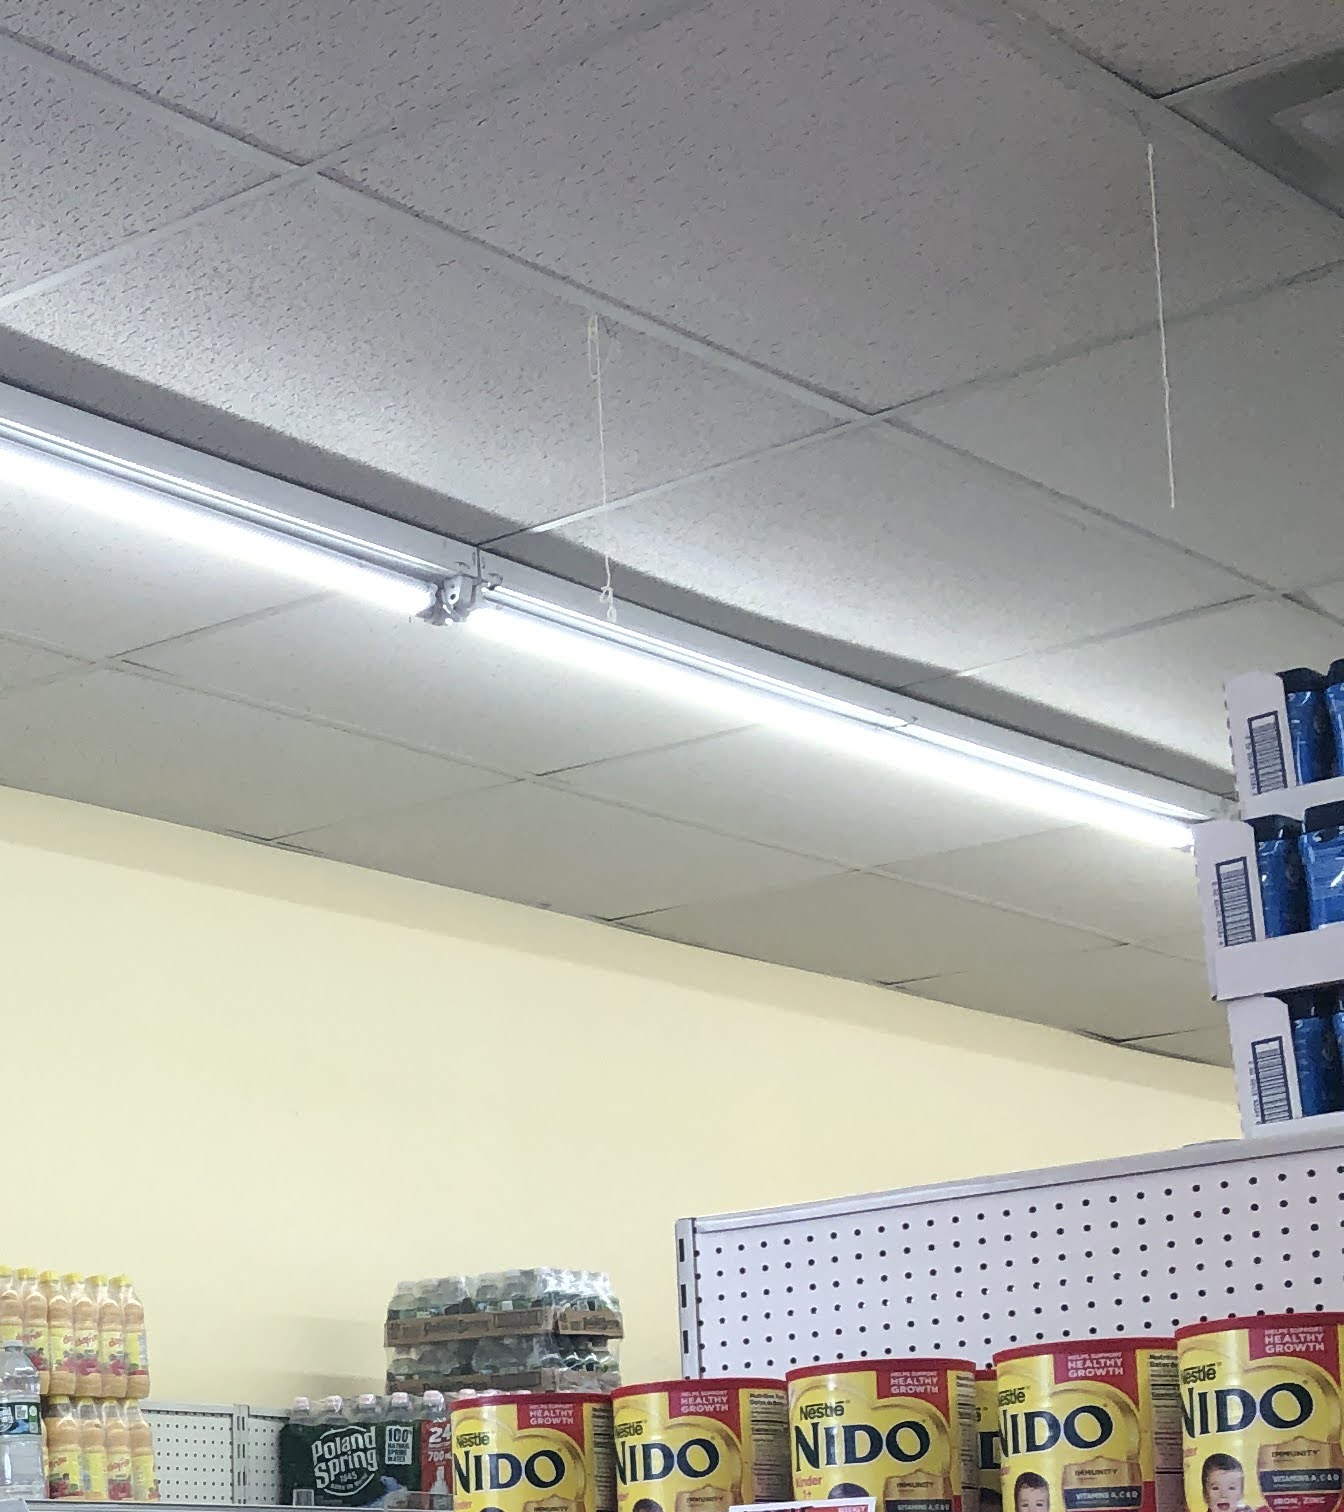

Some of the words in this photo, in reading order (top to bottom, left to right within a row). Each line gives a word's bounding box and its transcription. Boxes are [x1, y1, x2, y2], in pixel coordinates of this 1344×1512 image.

[1265, 1333, 1323, 1344] HEALTHY
[1265, 1342, 1324, 1353] GROWTH
[1068, 1358, 1123, 1369] HEALTHY
[1068, 1367, 1123, 1377] GROWTH
[890, 1376, 938, 1386] HEALTHY
[890, 1384, 939, 1394] GROWTH
[681, 1396, 728, 1405] HEALTHY
[681, 1403, 728, 1413] GROWTH
[800, 1402, 844, 1420] Nestlé
[1182, 1382, 1313, 1438] NIDO
[530, 1410, 574, 1418] HEALTHY
[530, 1417, 573, 1425] GROWTH
[429, 1424, 451, 1442] 24
[998, 1404, 1114, 1458] NIDO
[312, 1426, 376, 1465] Poland
[795, 1421, 930, 1472] NIDO
[616, 1438, 719, 1487] NIDO
[314, 1449, 378, 1489] Spring
[454, 1450, 566, 1495] NIDO
[1304, 1496, 1325, 1505] ZINC
